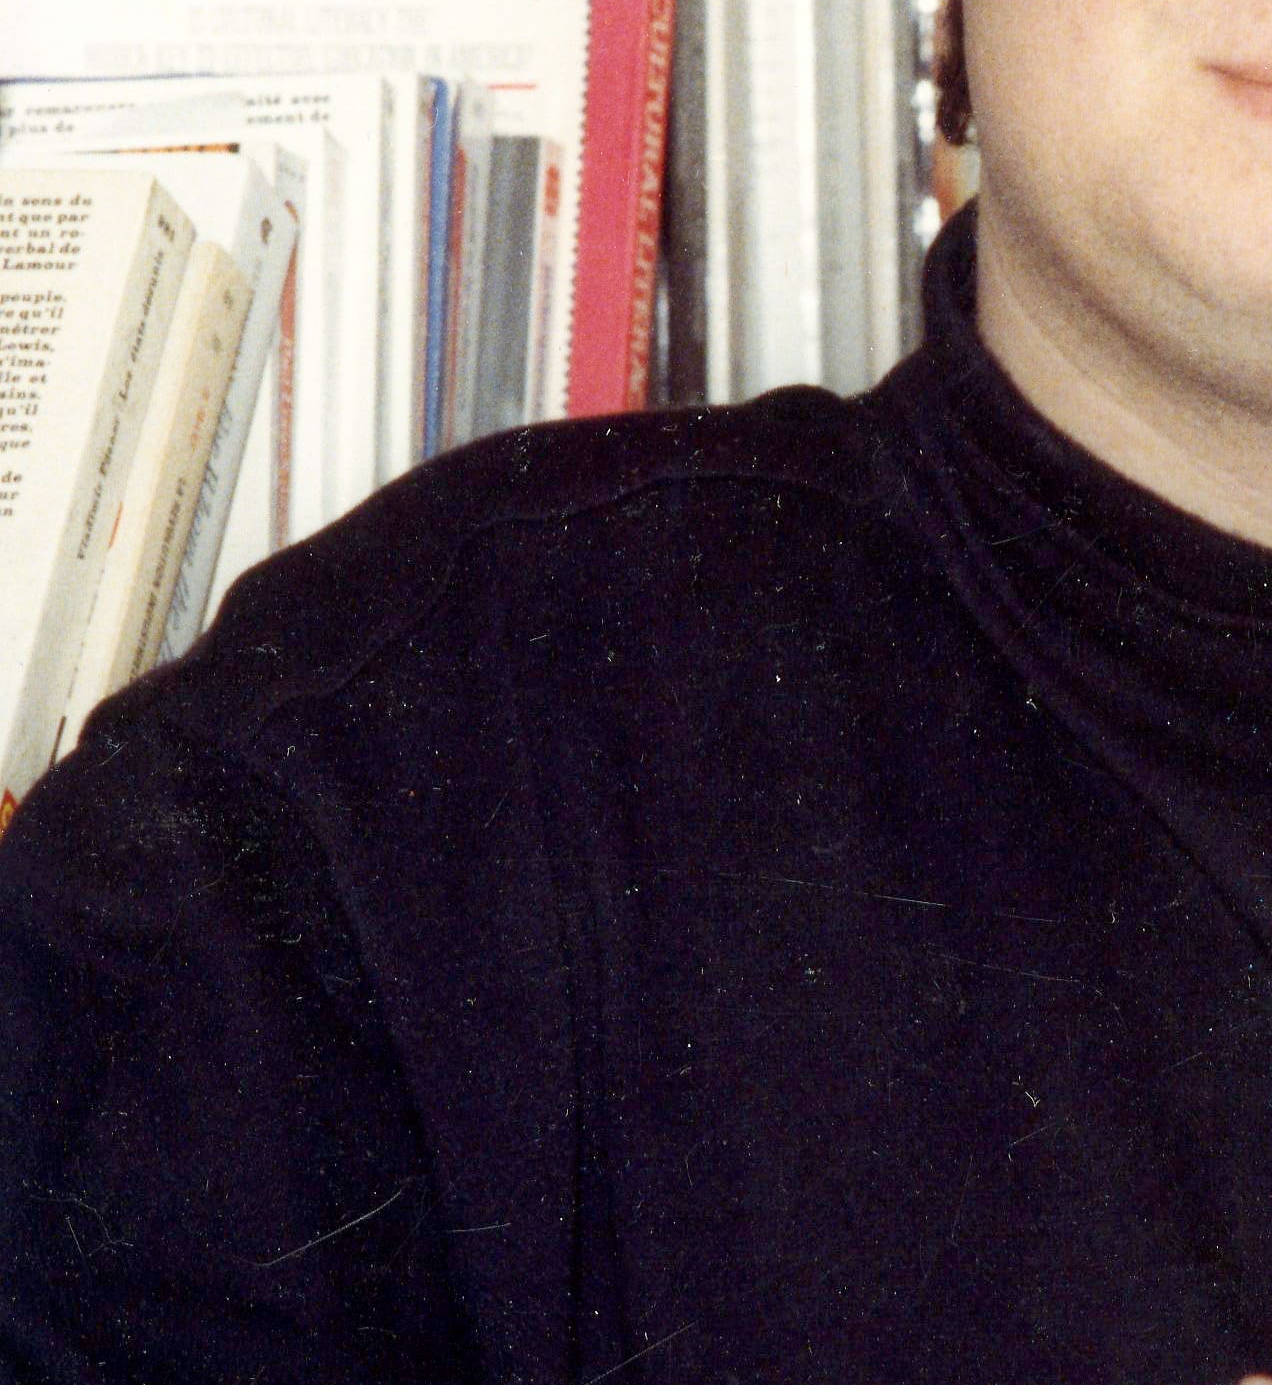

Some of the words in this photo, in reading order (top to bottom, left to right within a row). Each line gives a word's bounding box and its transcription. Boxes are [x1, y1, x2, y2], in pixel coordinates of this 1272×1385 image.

[55, 118, 75, 133] de
[22, 197, 62, 207] sens
[69, 192, 92, 206] du
[19, 213, 52, 226] que
[57, 213, 89, 226] par
[28, 228, 50, 239] un
[59, 241, 81, 254] de
[3, 258, 77, 271] Lamour
[19, 306, 64, 320] qu'il
[28, 373, 47, 383] et
[0, 440, 30, 452] que
[1, 470, 22, 483] de
